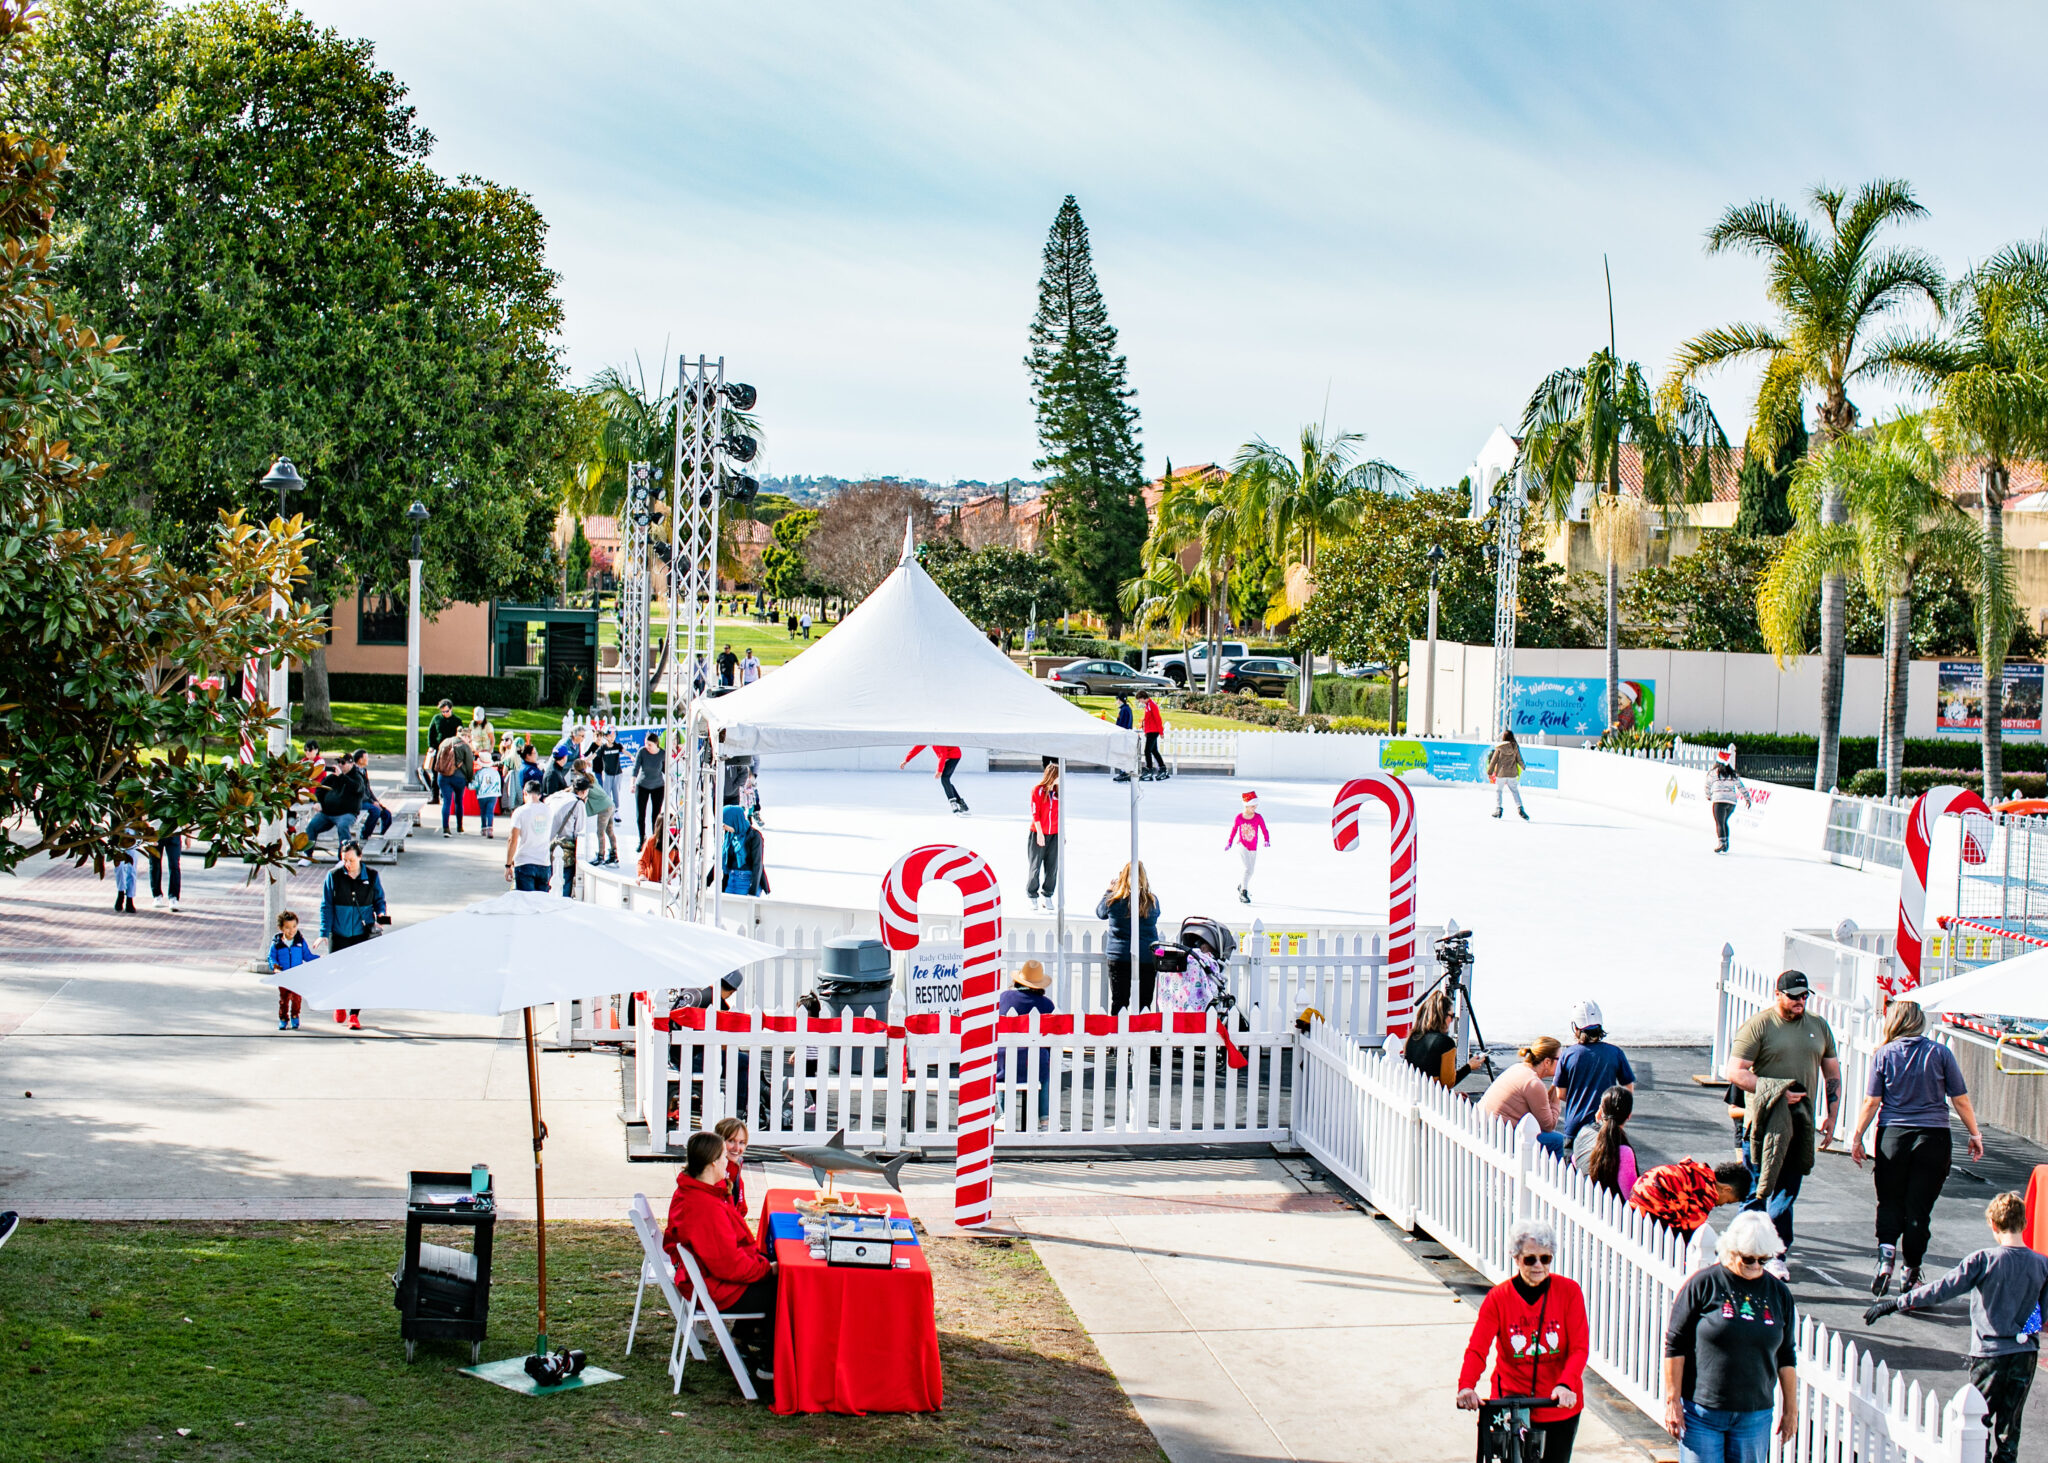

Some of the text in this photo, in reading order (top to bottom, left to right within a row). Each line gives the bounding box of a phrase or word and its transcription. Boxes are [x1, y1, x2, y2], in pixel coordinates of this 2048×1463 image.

[1529, 681, 1575, 696] Welcome to
[1525, 699, 1545, 708] Rady
[1516, 710, 1570, 728] Ice Rink
[1384, 757, 1405, 768] Light
[1414, 758, 1429, 769] Way
[920, 952, 963, 962] Rady Childre
[913, 963, 959, 980] Ice Rink
